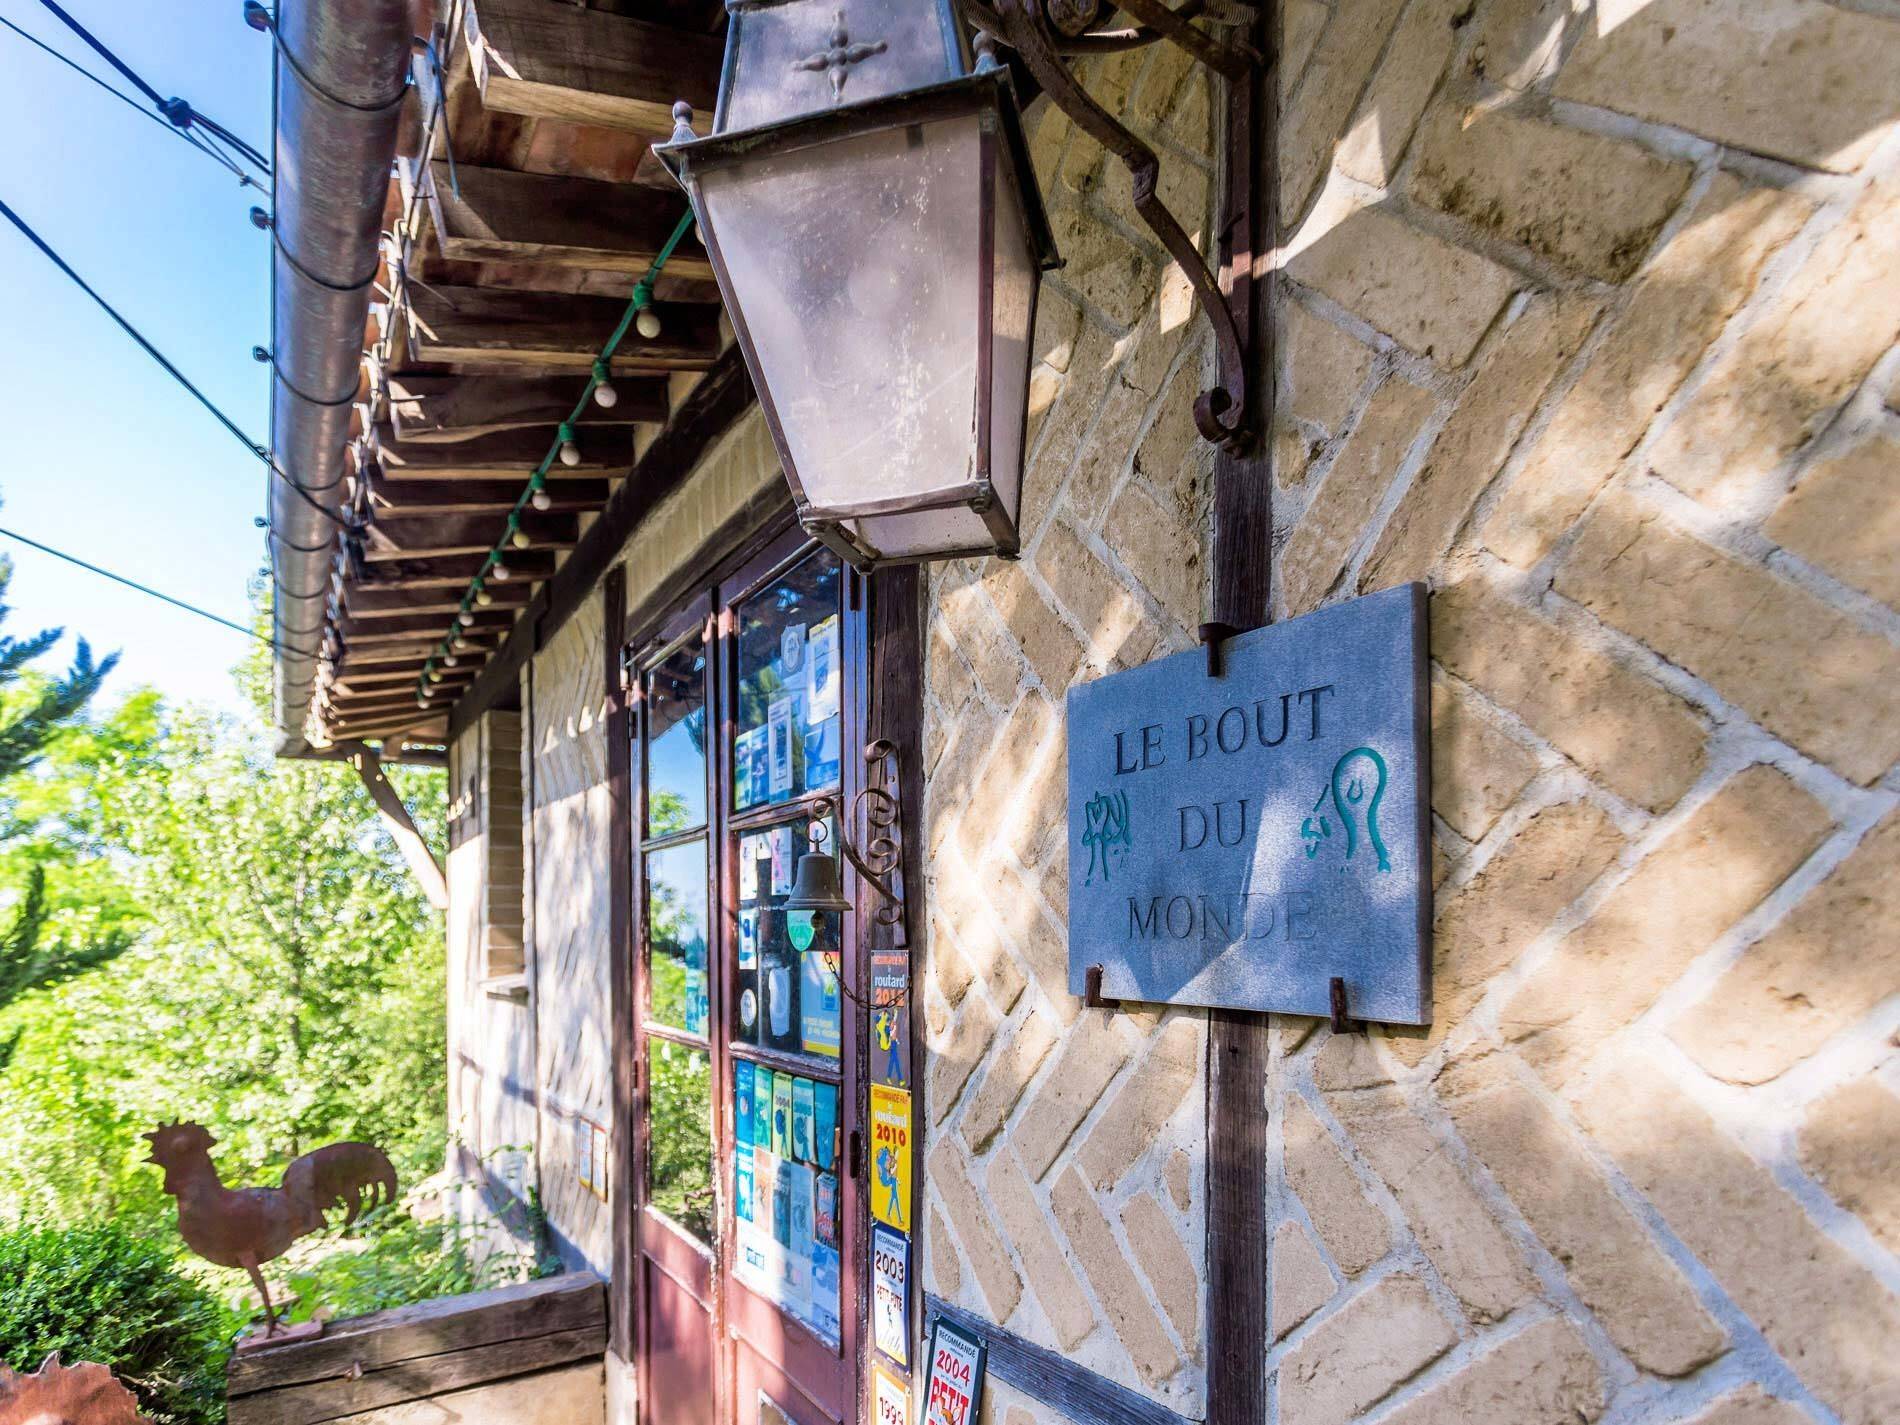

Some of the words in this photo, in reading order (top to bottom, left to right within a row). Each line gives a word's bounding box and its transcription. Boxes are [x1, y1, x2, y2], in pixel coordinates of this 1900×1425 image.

[1114, 724, 1166, 775] LE
[1185, 684, 1335, 763] BOUT
[1176, 798, 1249, 853] DU
[1127, 893, 1317, 942] MONDE
[875, 974, 905, 987] routard
[876, 1123, 906, 1146] 2010
[875, 1250, 904, 1283] 2003
[939, 1330, 976, 1359] RECOMMANDÉ
[937, 1350, 970, 1386] 2004
[879, 1396, 904, 1425] 1999
